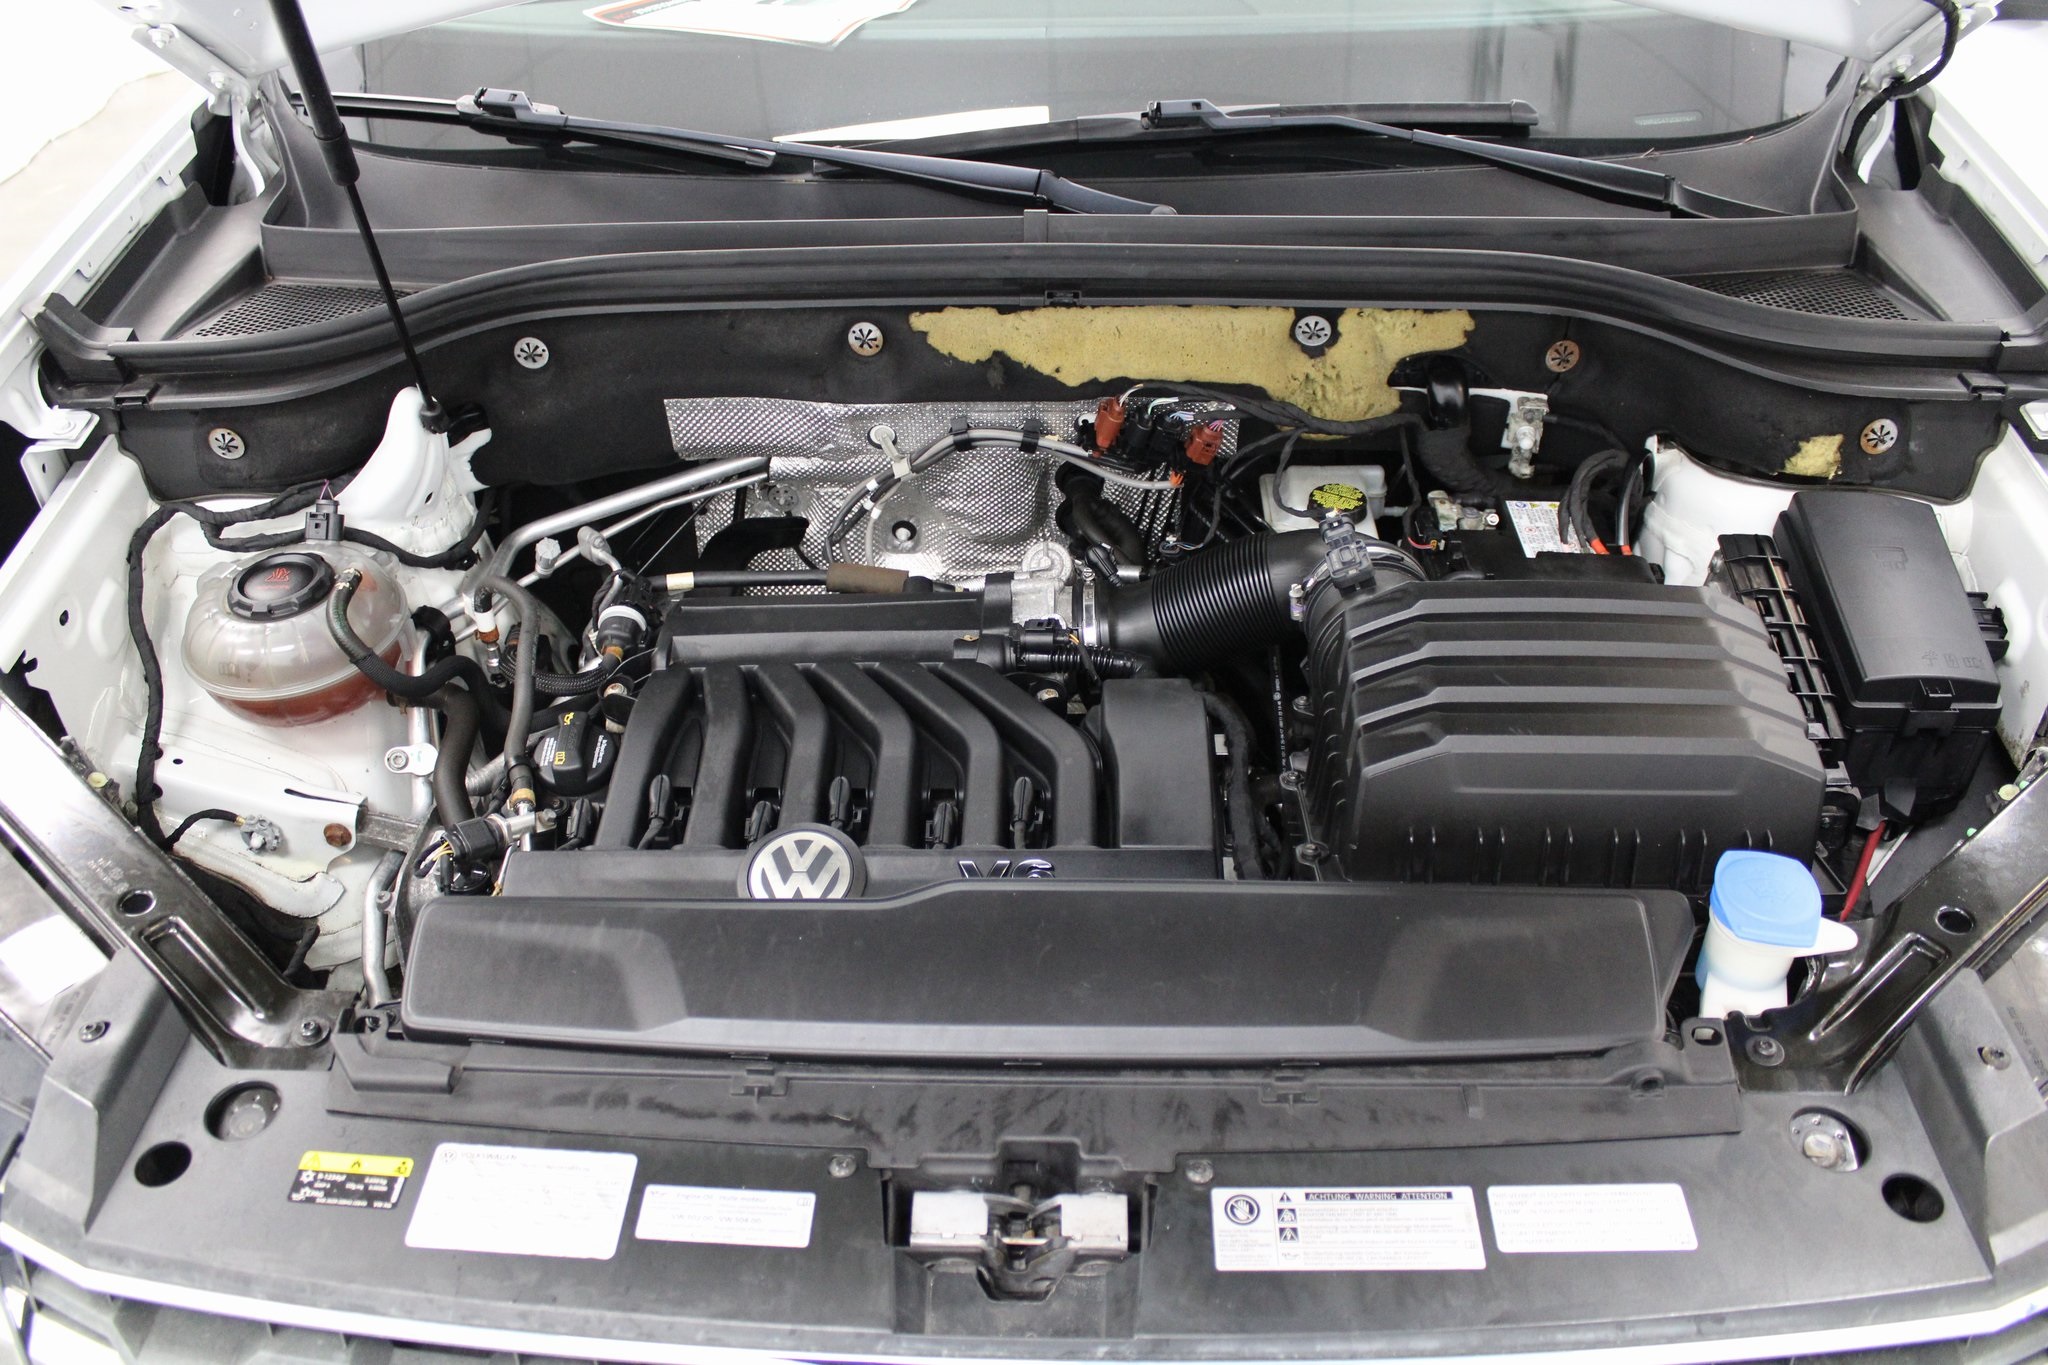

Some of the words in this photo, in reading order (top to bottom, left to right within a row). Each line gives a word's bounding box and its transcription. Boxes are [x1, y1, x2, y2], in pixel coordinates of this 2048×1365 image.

[750, 831, 850, 899] VW
[1308, 1192, 1350, 1201] ACHTUNG
[1355, 1192, 1397, 1201] WARNING
[1401, 1191, 1448, 1200] ATTENTION
